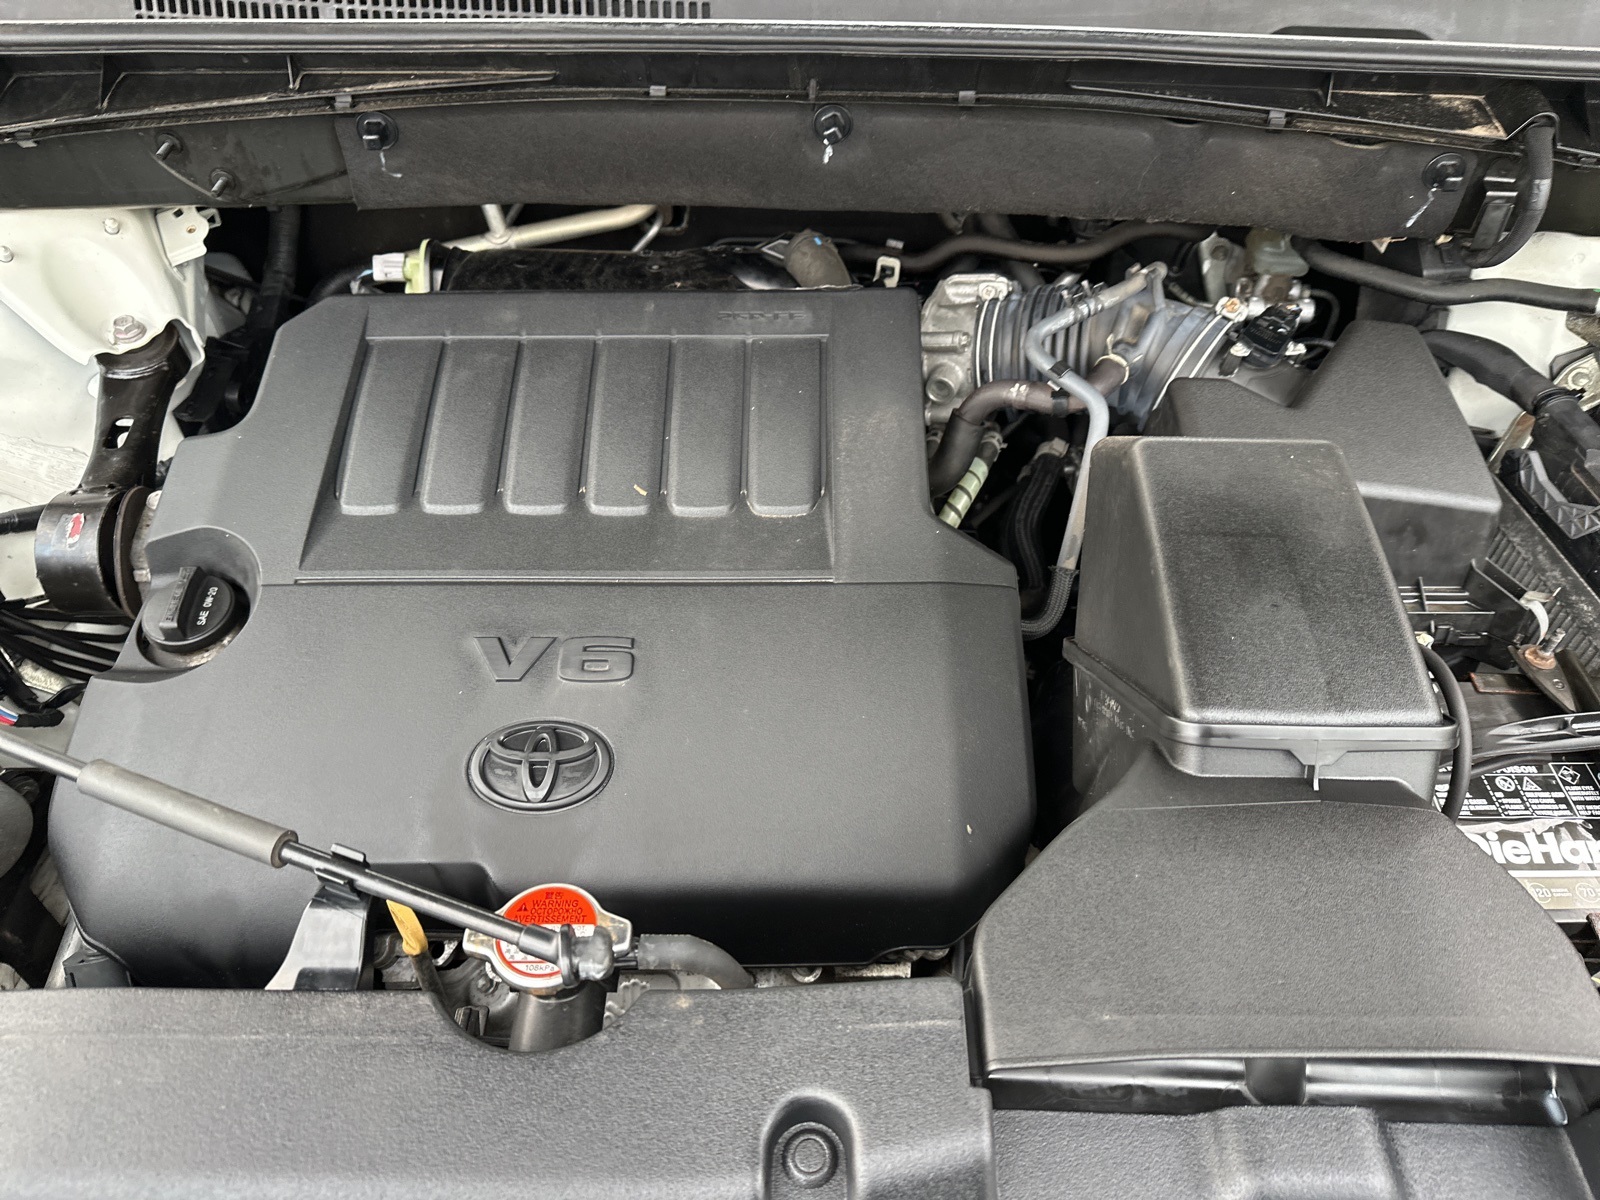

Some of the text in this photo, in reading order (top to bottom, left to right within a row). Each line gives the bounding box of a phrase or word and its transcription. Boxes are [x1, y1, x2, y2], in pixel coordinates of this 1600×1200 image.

[197, 586, 218, 626] SAE 0W-20
[473, 636, 635, 683] V6
[1578, 888, 1596, 898] 70
[532, 899, 579, 908] WARNING
[530, 907, 583, 915] ОСТОРОЖНО
[514, 915, 587, 923] AVERTISSEMENT
